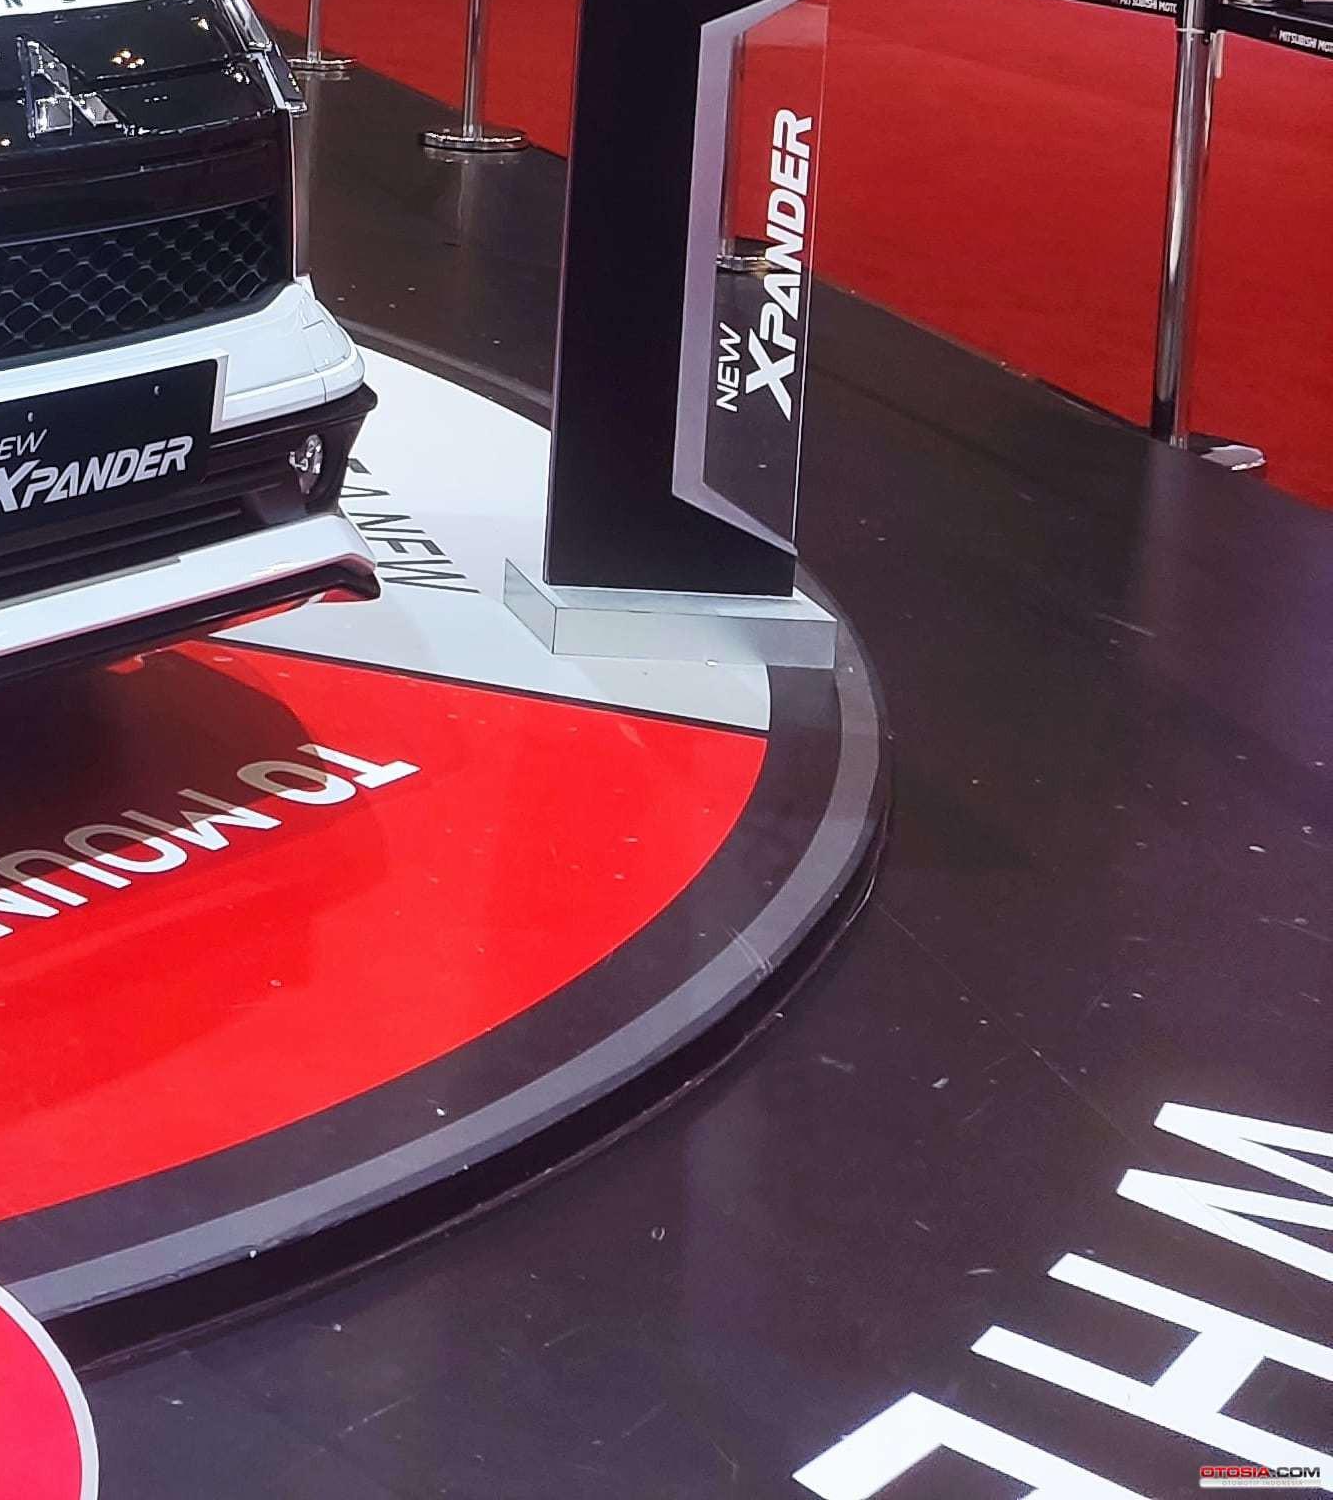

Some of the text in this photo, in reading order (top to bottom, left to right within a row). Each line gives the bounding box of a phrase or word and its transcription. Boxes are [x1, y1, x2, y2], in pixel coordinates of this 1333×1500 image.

[1278, 30, 1318, 49] MITSUBISHI
[745, 108, 813, 422] XPANDER
[716, 321, 741, 413] NEW
[235, 742, 422, 806] TO
